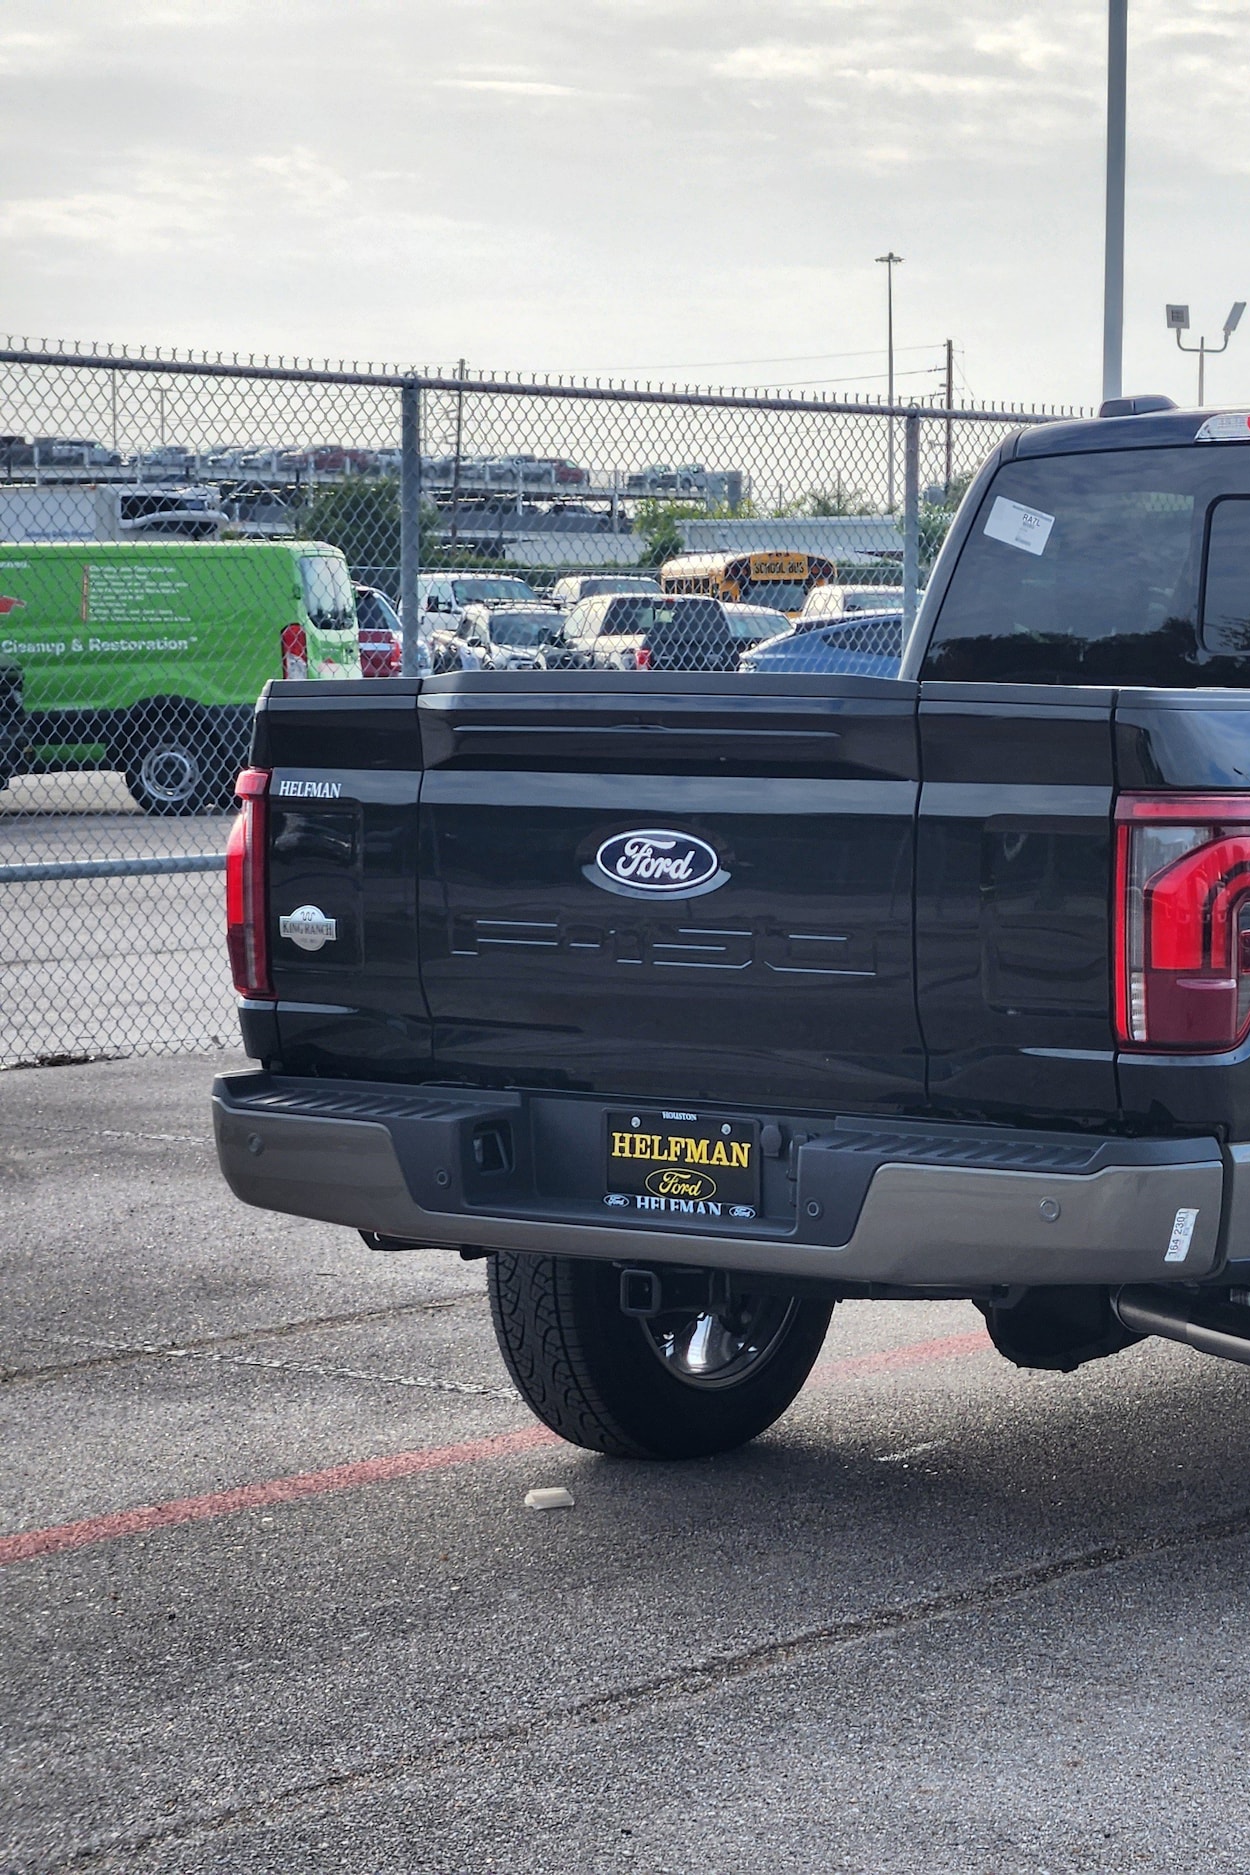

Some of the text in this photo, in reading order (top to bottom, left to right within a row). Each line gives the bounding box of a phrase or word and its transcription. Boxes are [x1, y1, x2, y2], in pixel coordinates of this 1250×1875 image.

[755, 562, 804, 573] SCHOOL BUS
[2, 640, 65, 654] Cleanup
[71, 638, 83, 651] &
[279, 781, 342, 798] HELFMAN
[616, 838, 695, 880] Ford
[661, 1111, 697, 1121] HOUSTON
[611, 1132, 751, 1168] HELFMAN
[658, 1171, 702, 1197] Ford
[1168, 1240, 1179, 1256] 164
